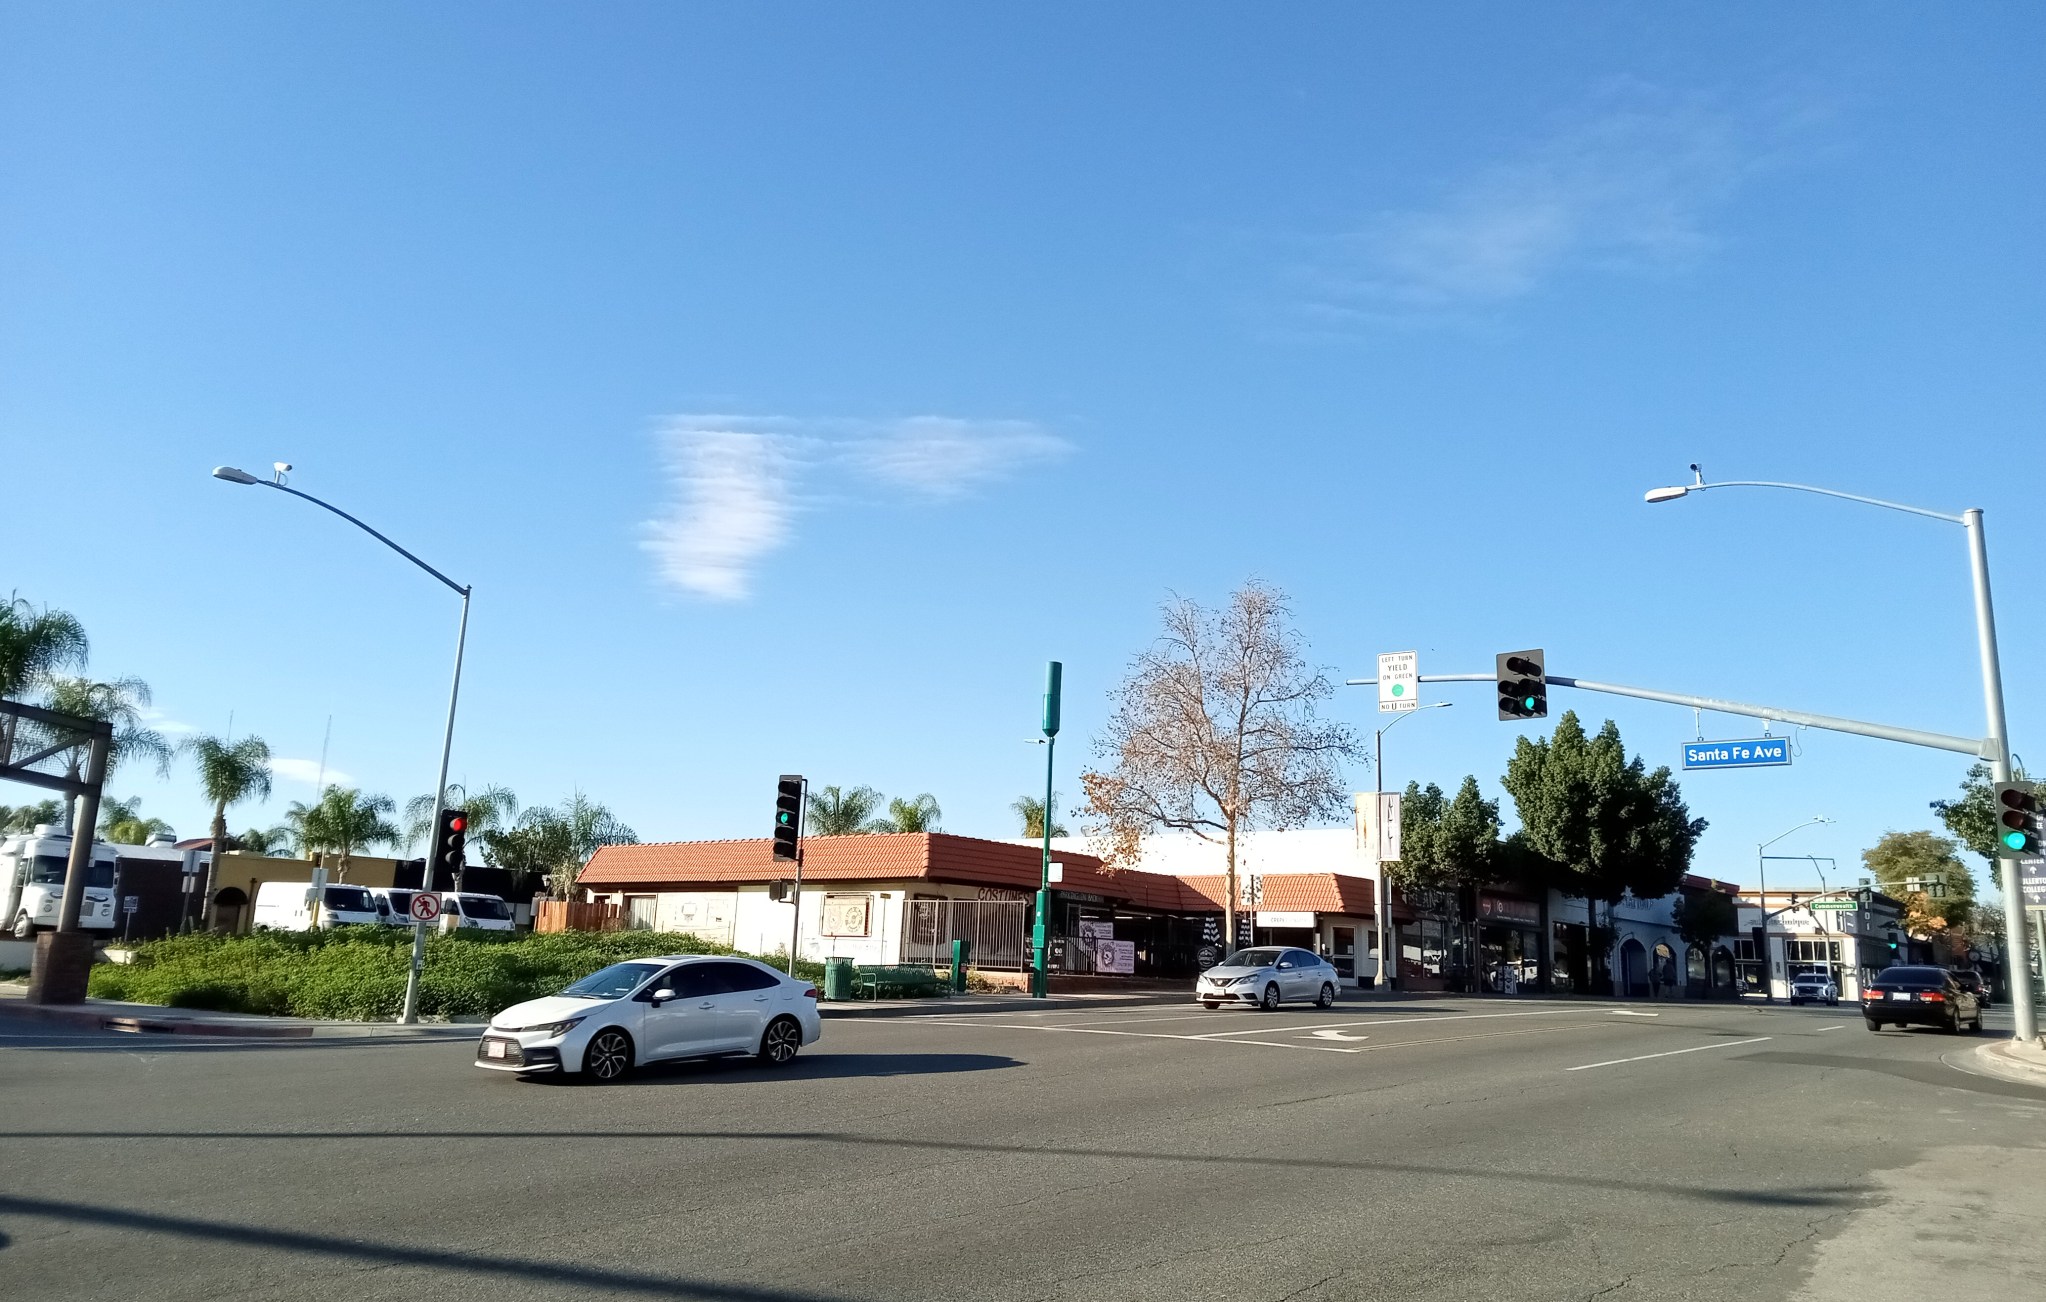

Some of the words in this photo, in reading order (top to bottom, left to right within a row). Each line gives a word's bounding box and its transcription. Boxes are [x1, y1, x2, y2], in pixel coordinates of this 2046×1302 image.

[1391, 702, 1397, 710] U
[1688, 748, 1729, 762] Santa
[1732, 746, 1750, 760] Fe
[1753, 745, 1782, 759] Ave
[978, 887, 1030, 906] COSTUMES
